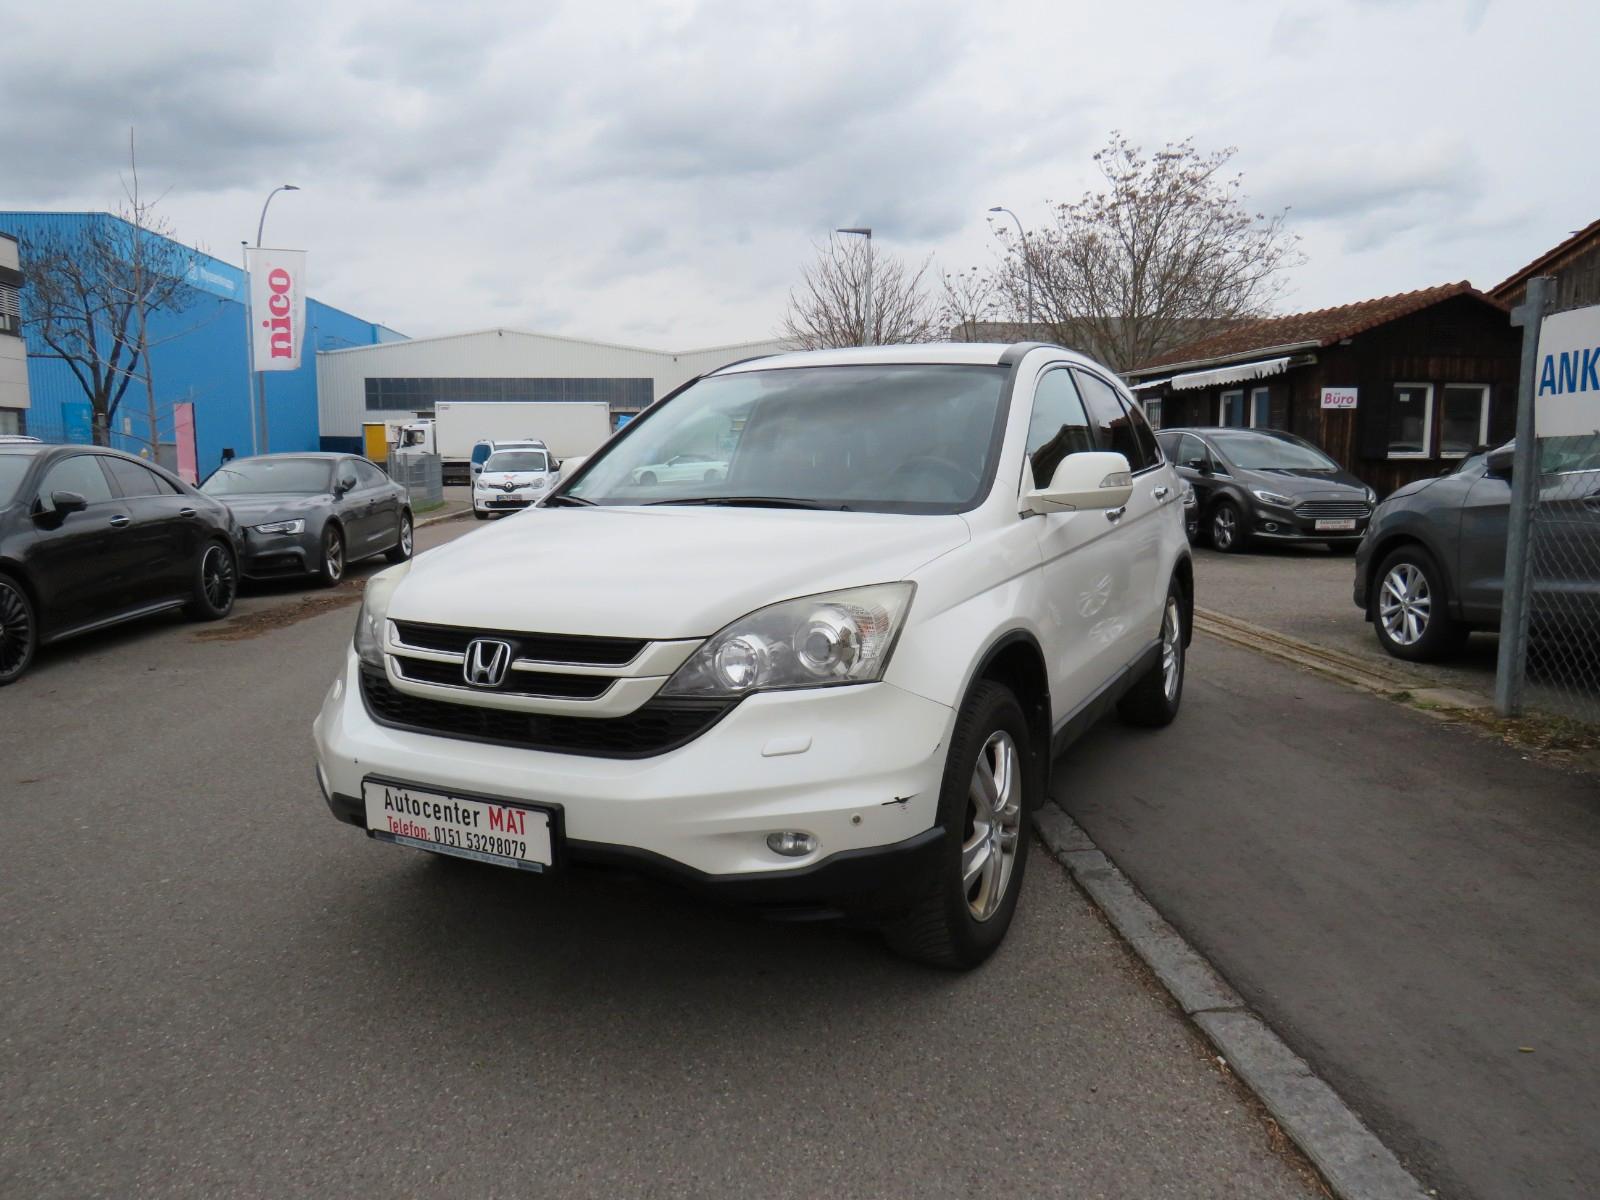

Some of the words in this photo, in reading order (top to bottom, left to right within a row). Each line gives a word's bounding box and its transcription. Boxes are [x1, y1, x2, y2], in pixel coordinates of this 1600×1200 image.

[262, 268, 291, 358] nico
[1324, 392, 1354, 404] Büro
[384, 788, 480, 827] Autocenter
[488, 806, 526, 835] MAT
[387, 816, 431, 841] Telefon:
[434, 826, 461, 846] 0151
[466, 833, 527, 858] 53298079
